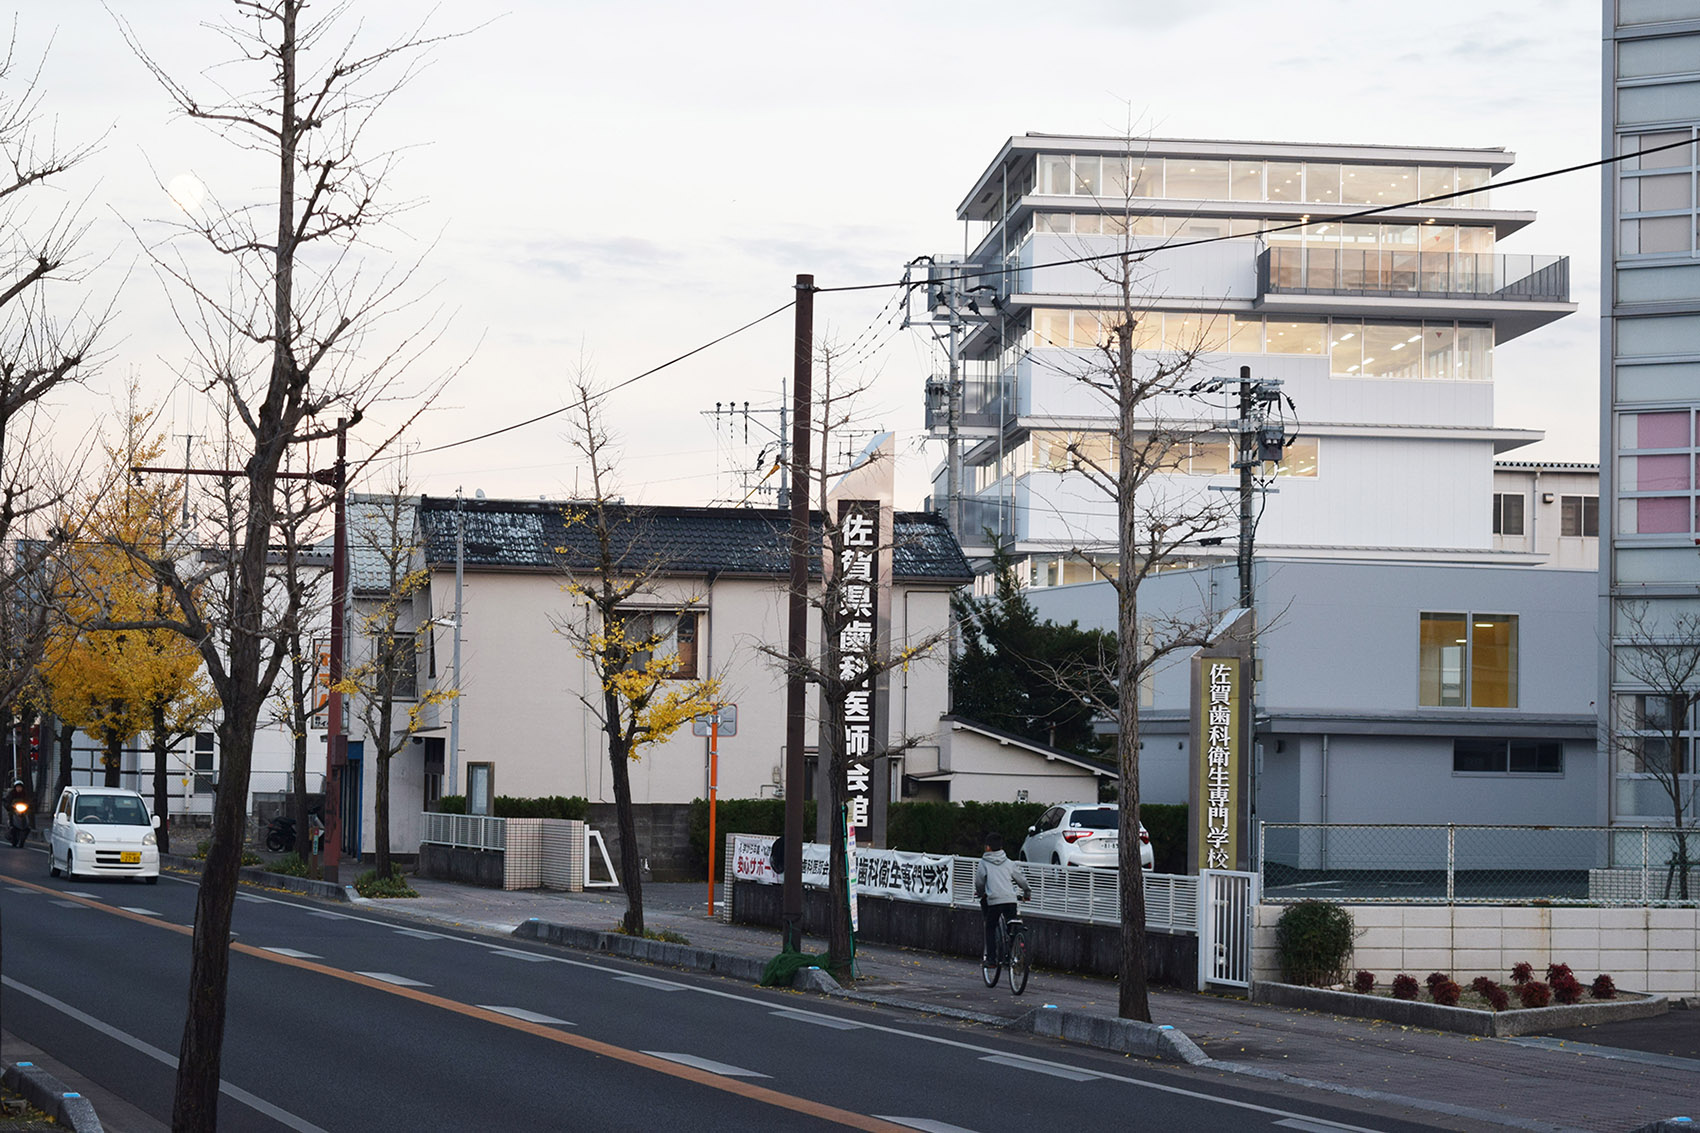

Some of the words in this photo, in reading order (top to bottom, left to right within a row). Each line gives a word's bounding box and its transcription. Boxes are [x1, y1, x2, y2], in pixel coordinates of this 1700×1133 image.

[1207, 663, 1232, 869] 佐賀歯科衛生専門学校
[737, 856, 776, 878] 安心サポー
[856, 857, 949, 894] 歯科衛生専門学校
